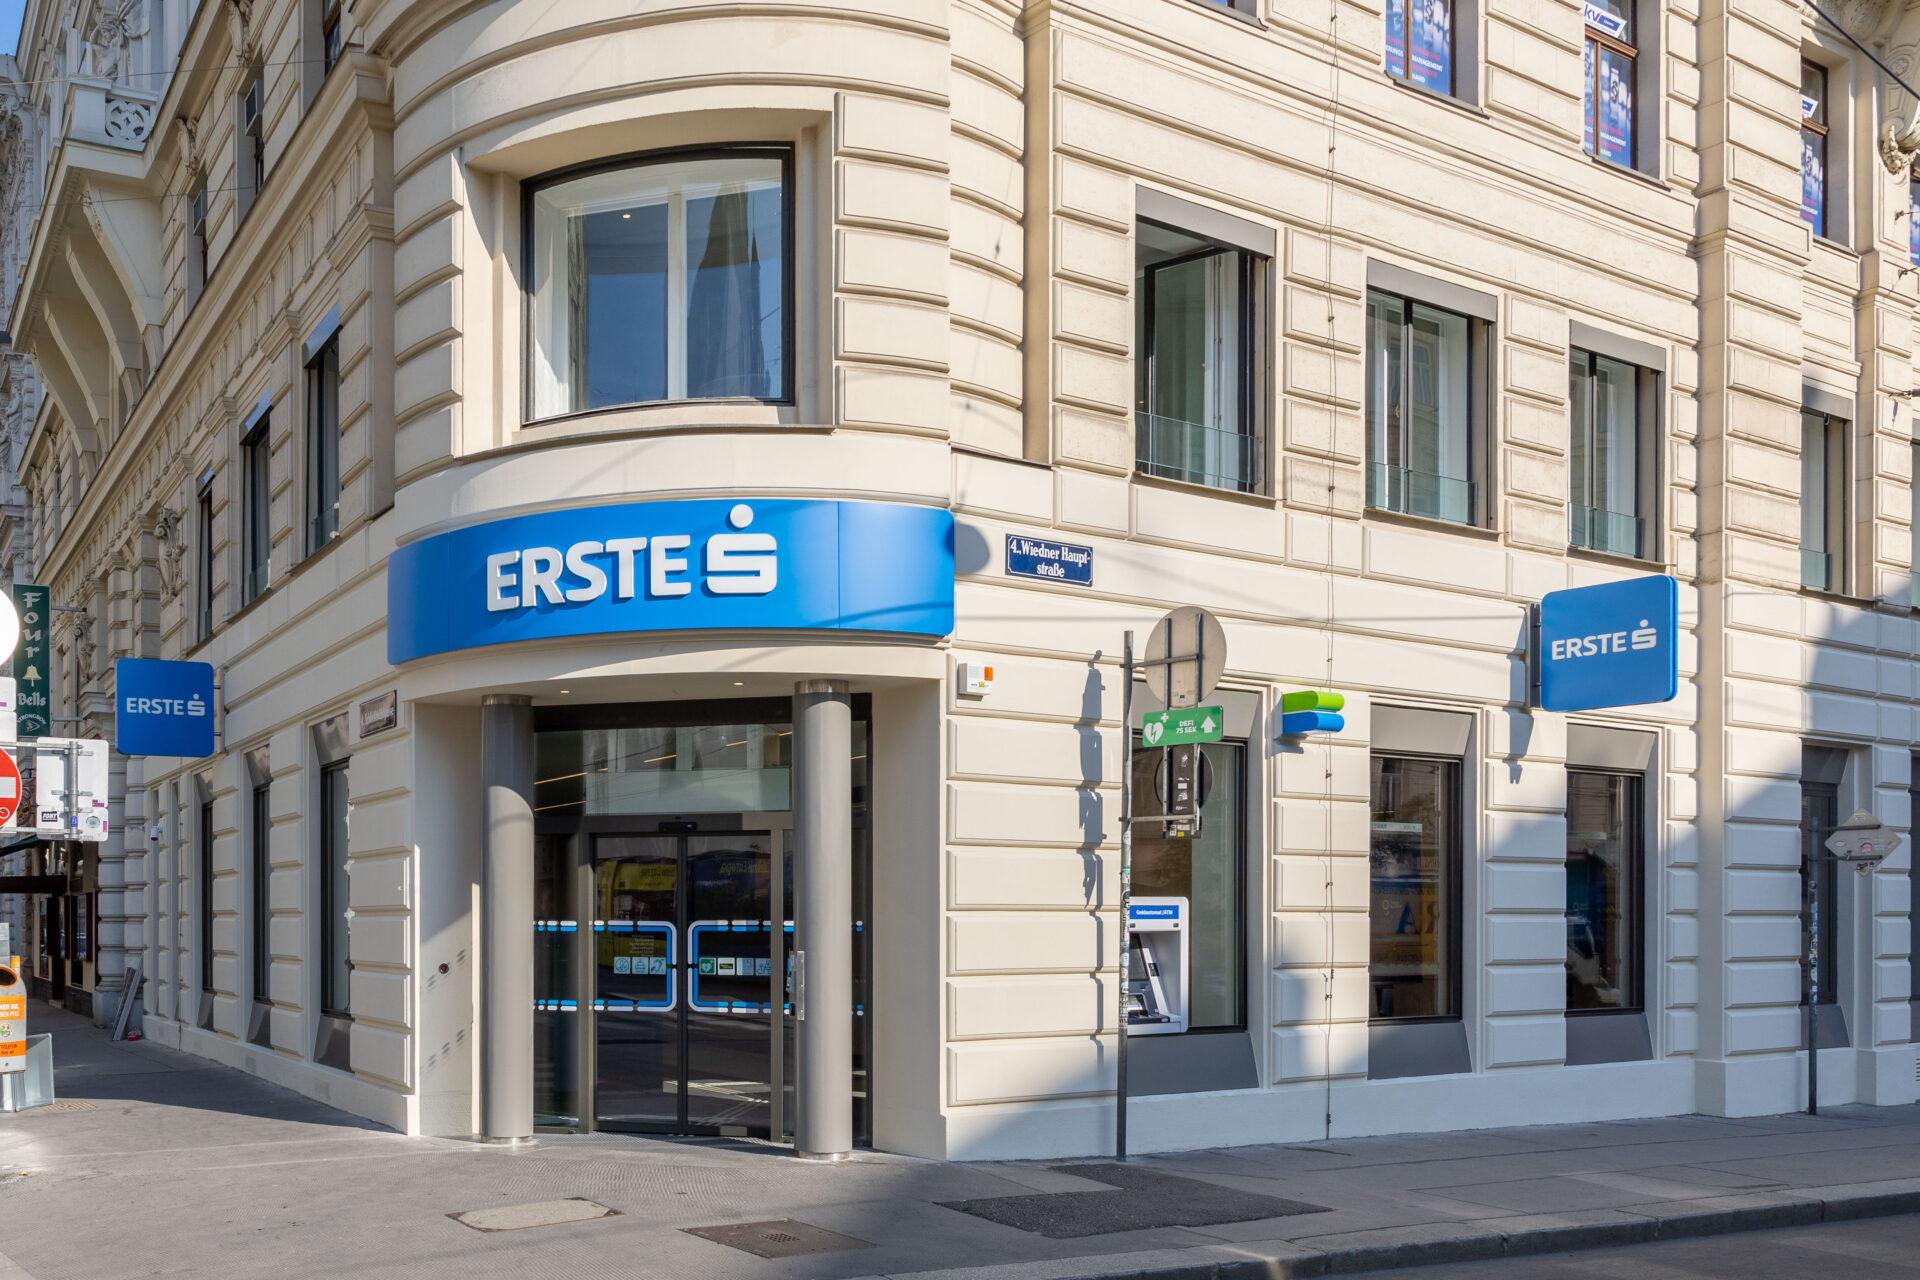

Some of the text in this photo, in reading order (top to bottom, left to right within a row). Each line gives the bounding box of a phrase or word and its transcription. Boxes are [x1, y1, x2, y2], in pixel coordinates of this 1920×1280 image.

[486, 534, 692, 612] ERSTE
[1036, 562, 1066, 578] straße
[1551, 631, 1628, 661] ERSTE
[17, 692, 47, 707] Bells
[126, 697, 185, 716] ERSTE
[1179, 719, 1194, 727] DEFI
[1184, 725, 1198, 734] SEK
